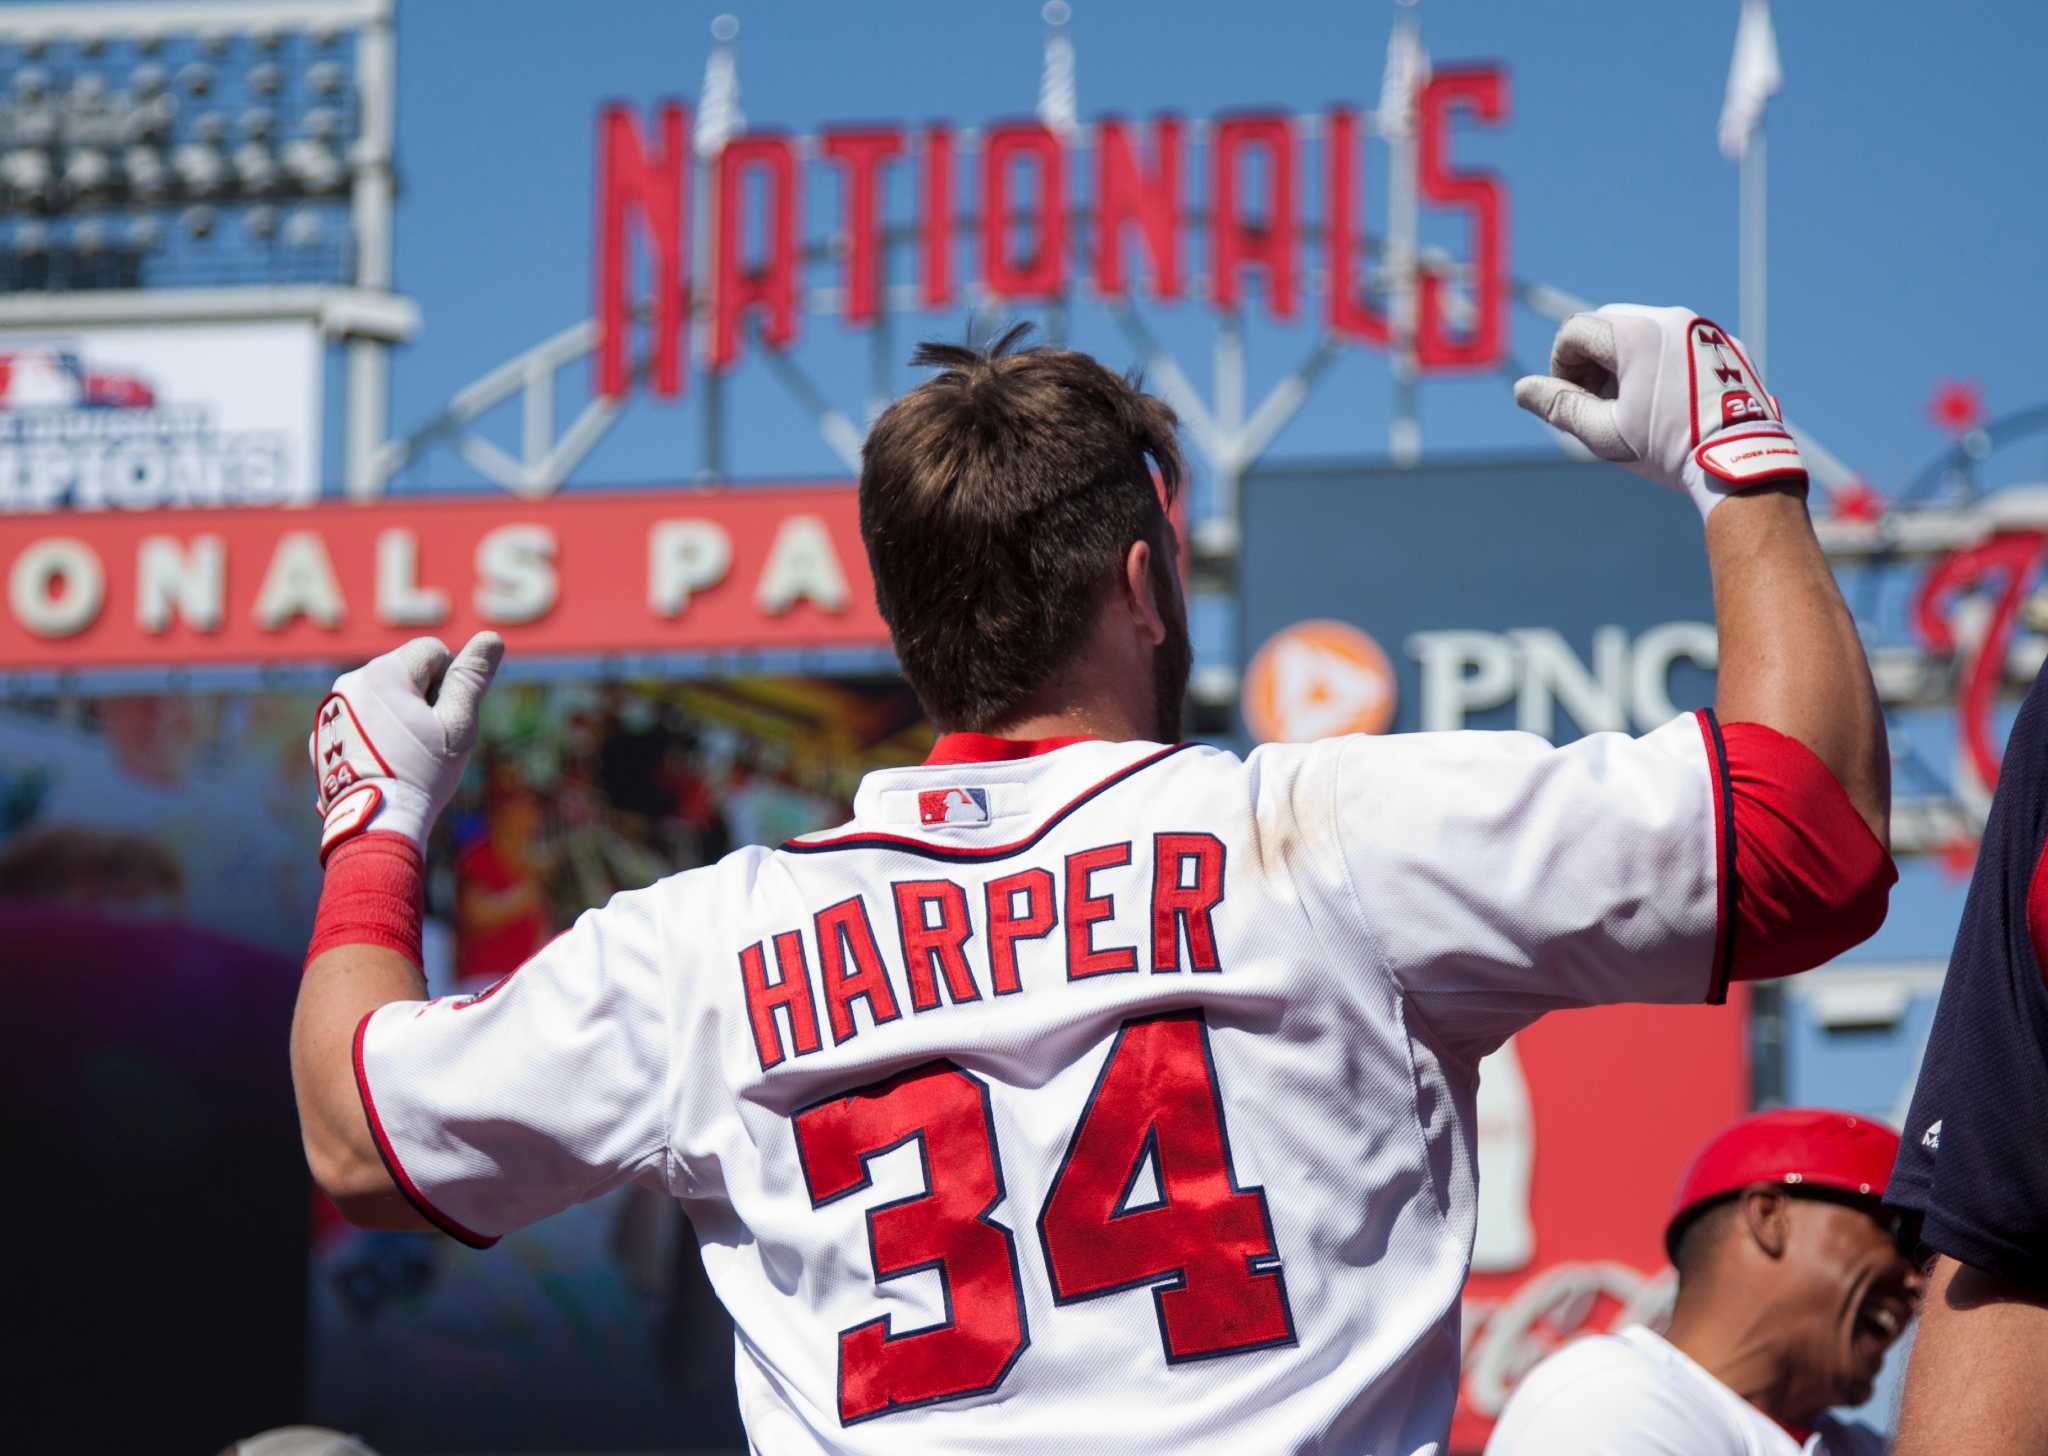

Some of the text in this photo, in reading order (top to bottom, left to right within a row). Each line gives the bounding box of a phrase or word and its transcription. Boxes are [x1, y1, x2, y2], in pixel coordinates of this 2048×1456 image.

[595, 64, 1507, 397] NATIONALS
[1726, 397, 1763, 418] 34
[1406, 621, 1718, 739] PNC
[325, 766, 352, 795] 34
[738, 832, 1227, 1072] HARPER
[791, 1006, 1298, 1427] 34
